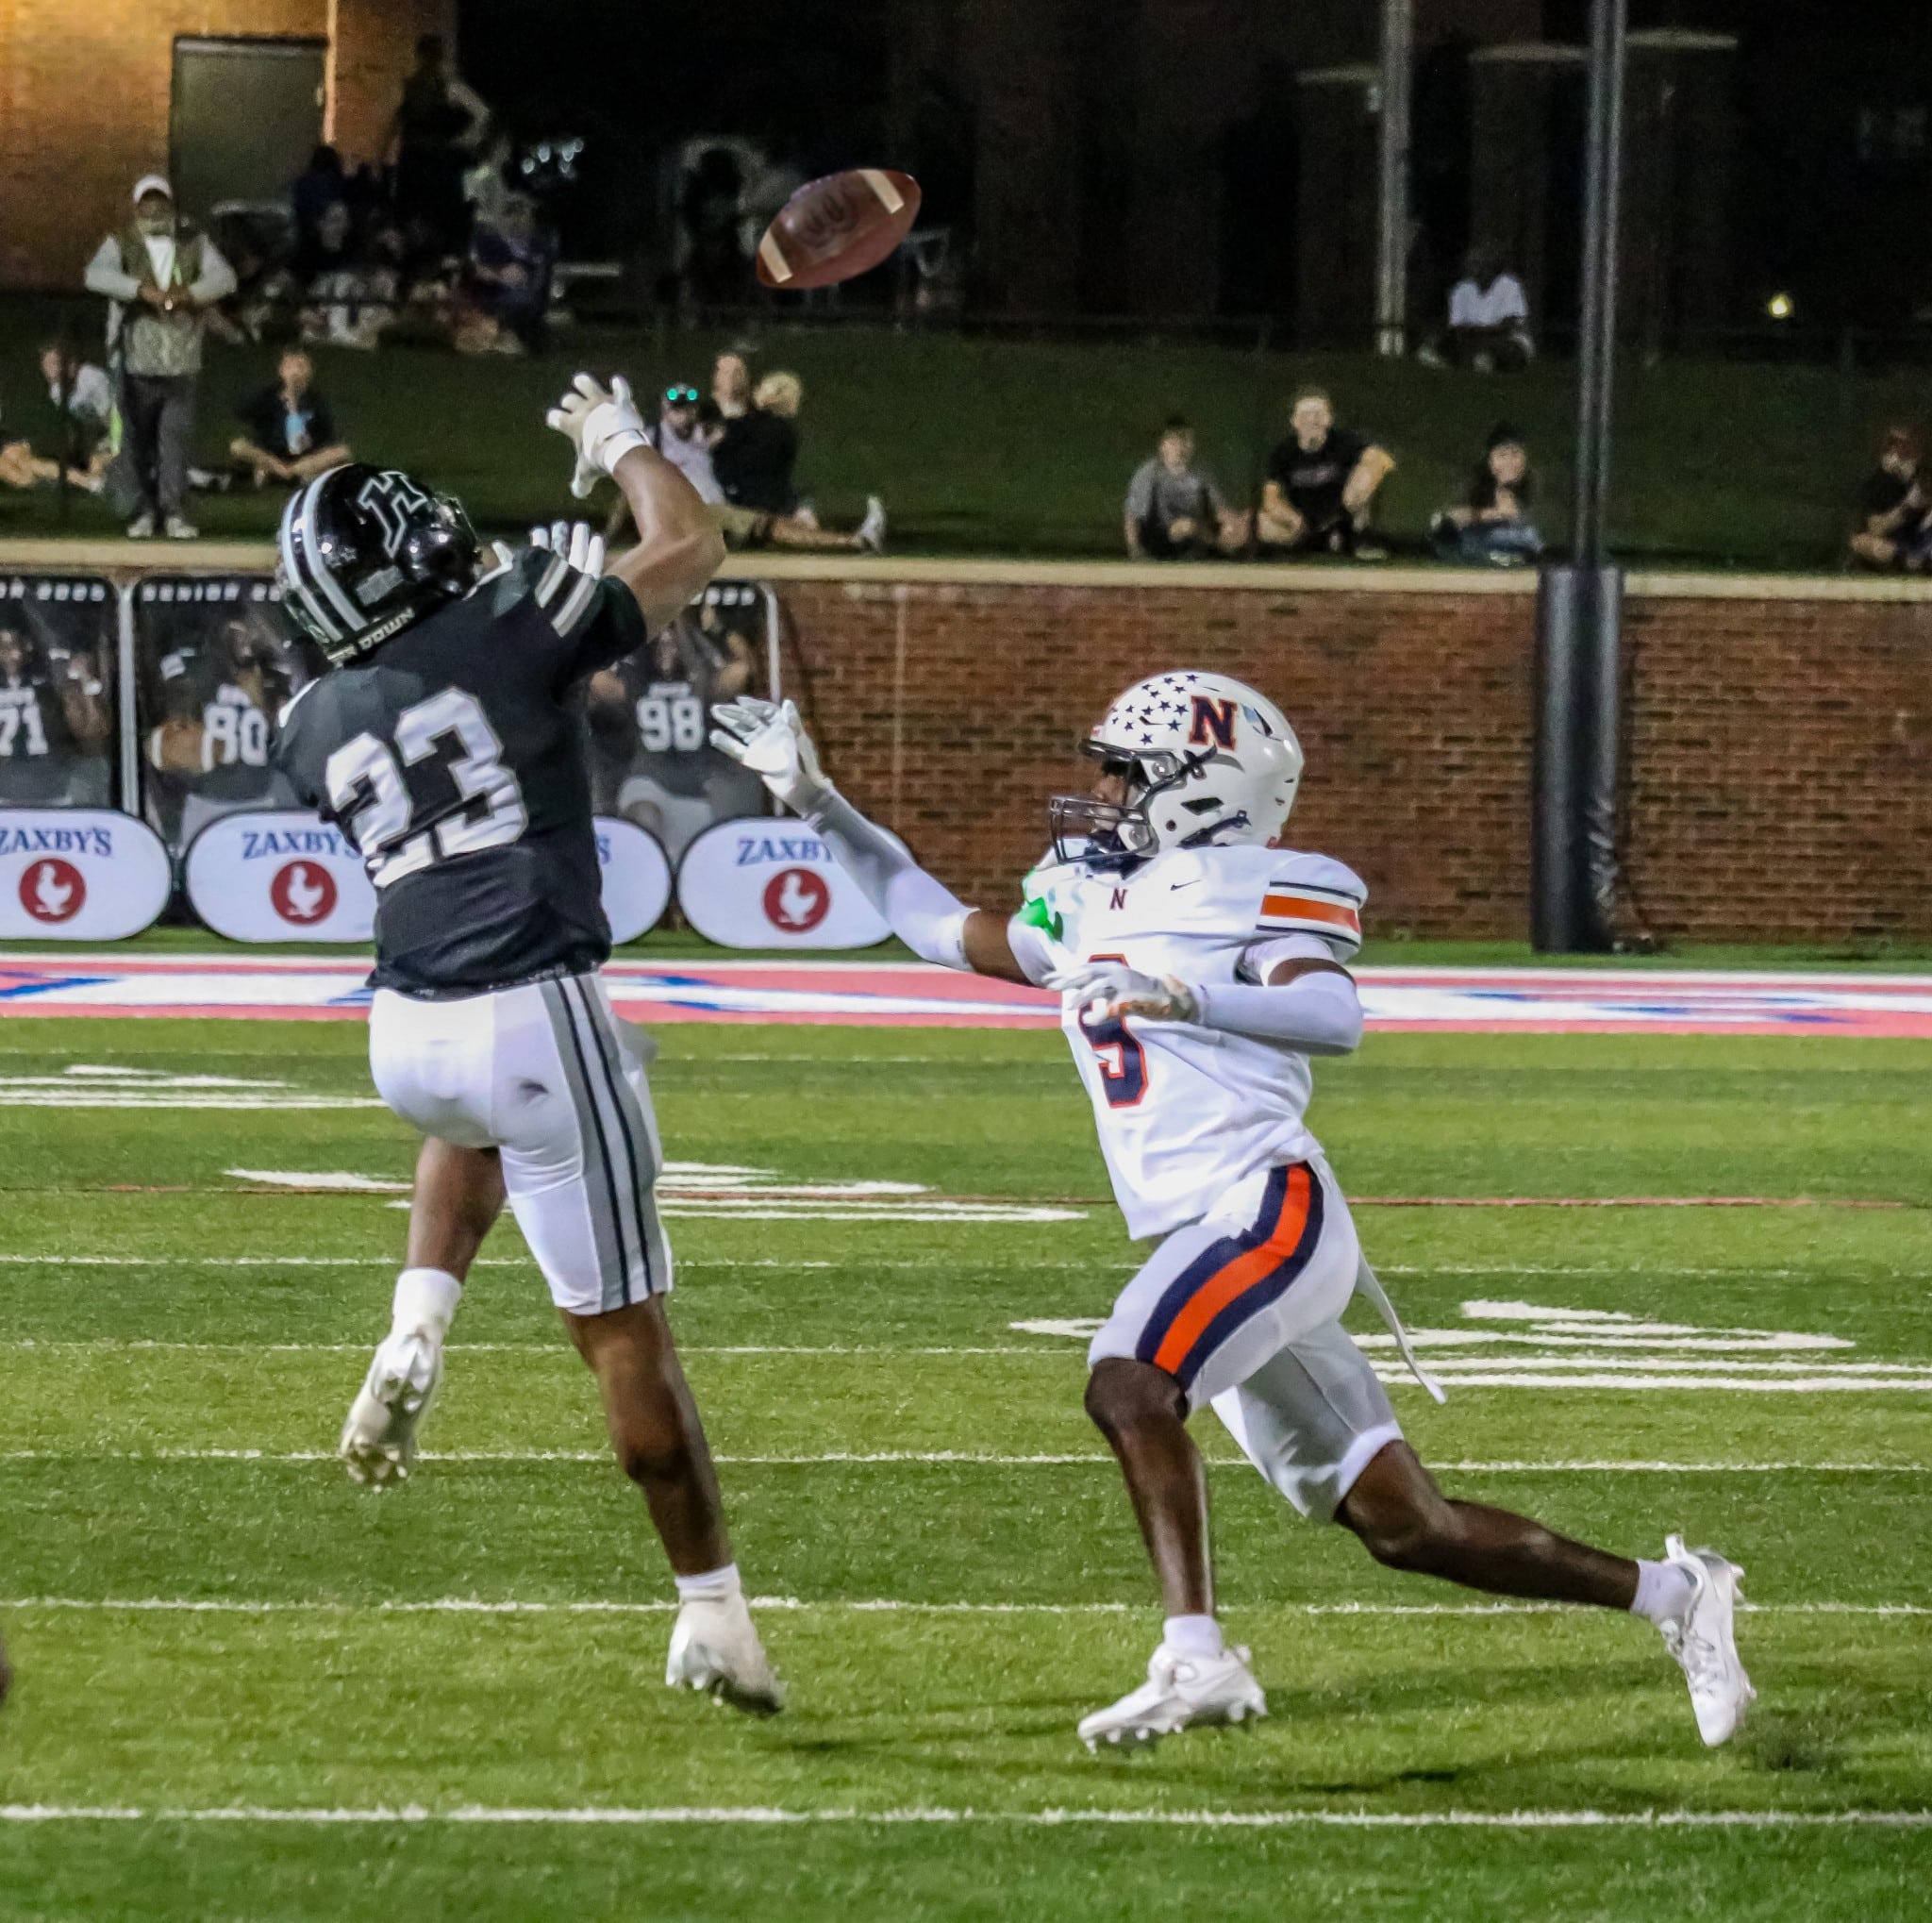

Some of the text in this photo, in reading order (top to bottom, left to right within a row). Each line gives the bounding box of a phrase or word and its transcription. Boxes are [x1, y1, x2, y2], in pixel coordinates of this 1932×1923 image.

[635, 695, 705, 752] 98
[1189, 694, 1238, 752] N
[325, 685, 528, 889] 23
[0, 825, 112, 858] ZAXBY'S
[242, 828, 362, 861] ZAXBY
[736, 836, 834, 867] ZAXBY
[1109, 887, 1129, 911] N
